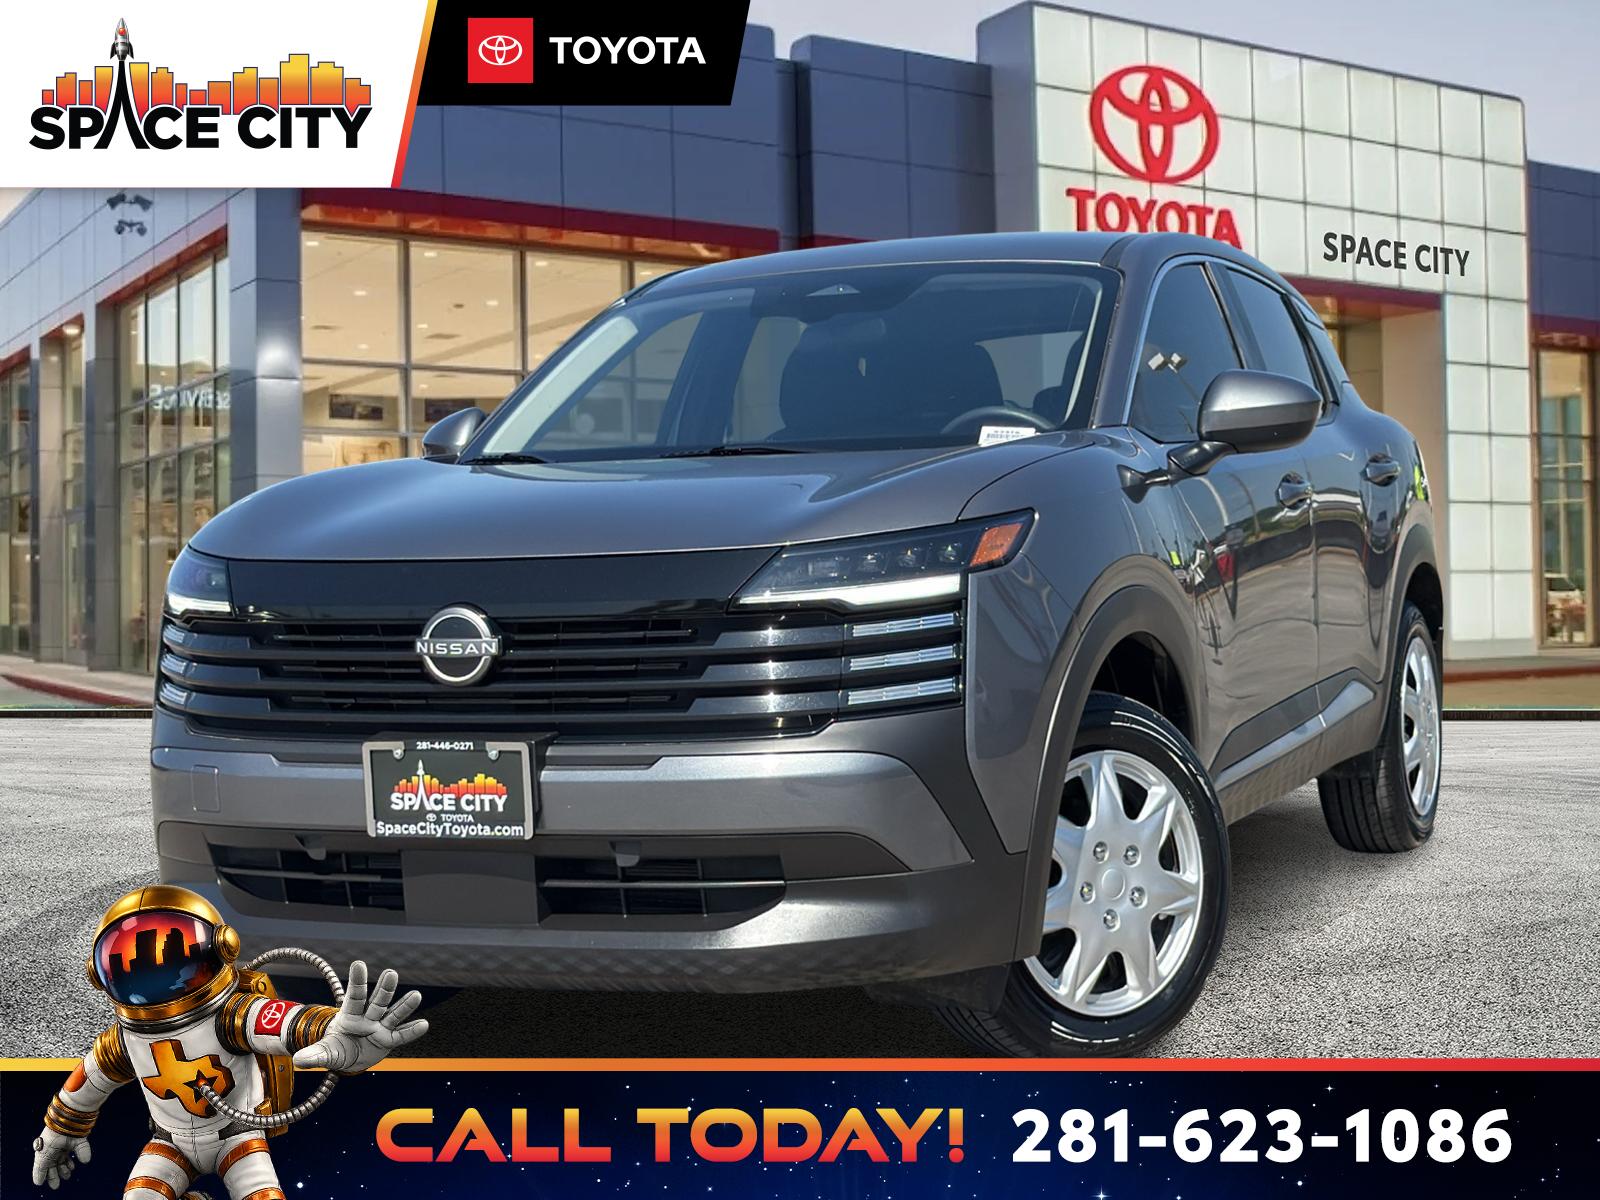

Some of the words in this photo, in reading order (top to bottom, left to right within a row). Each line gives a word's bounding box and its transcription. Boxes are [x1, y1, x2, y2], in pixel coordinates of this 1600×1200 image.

[1066, 188, 1243, 250] TOYOTA
[1323, 231, 1407, 270] SPACE
[1414, 243, 1470, 277] CITY
[416, 640, 497, 655] NISSAN
[416, 741, 474, 751] 281-446-0271
[390, 793, 456, 811] SPACE
[460, 794, 508, 812] CITY
[440, 814, 475, 823] TOYOTA
[376, 821, 524, 837] SpaceCityToyota.com
